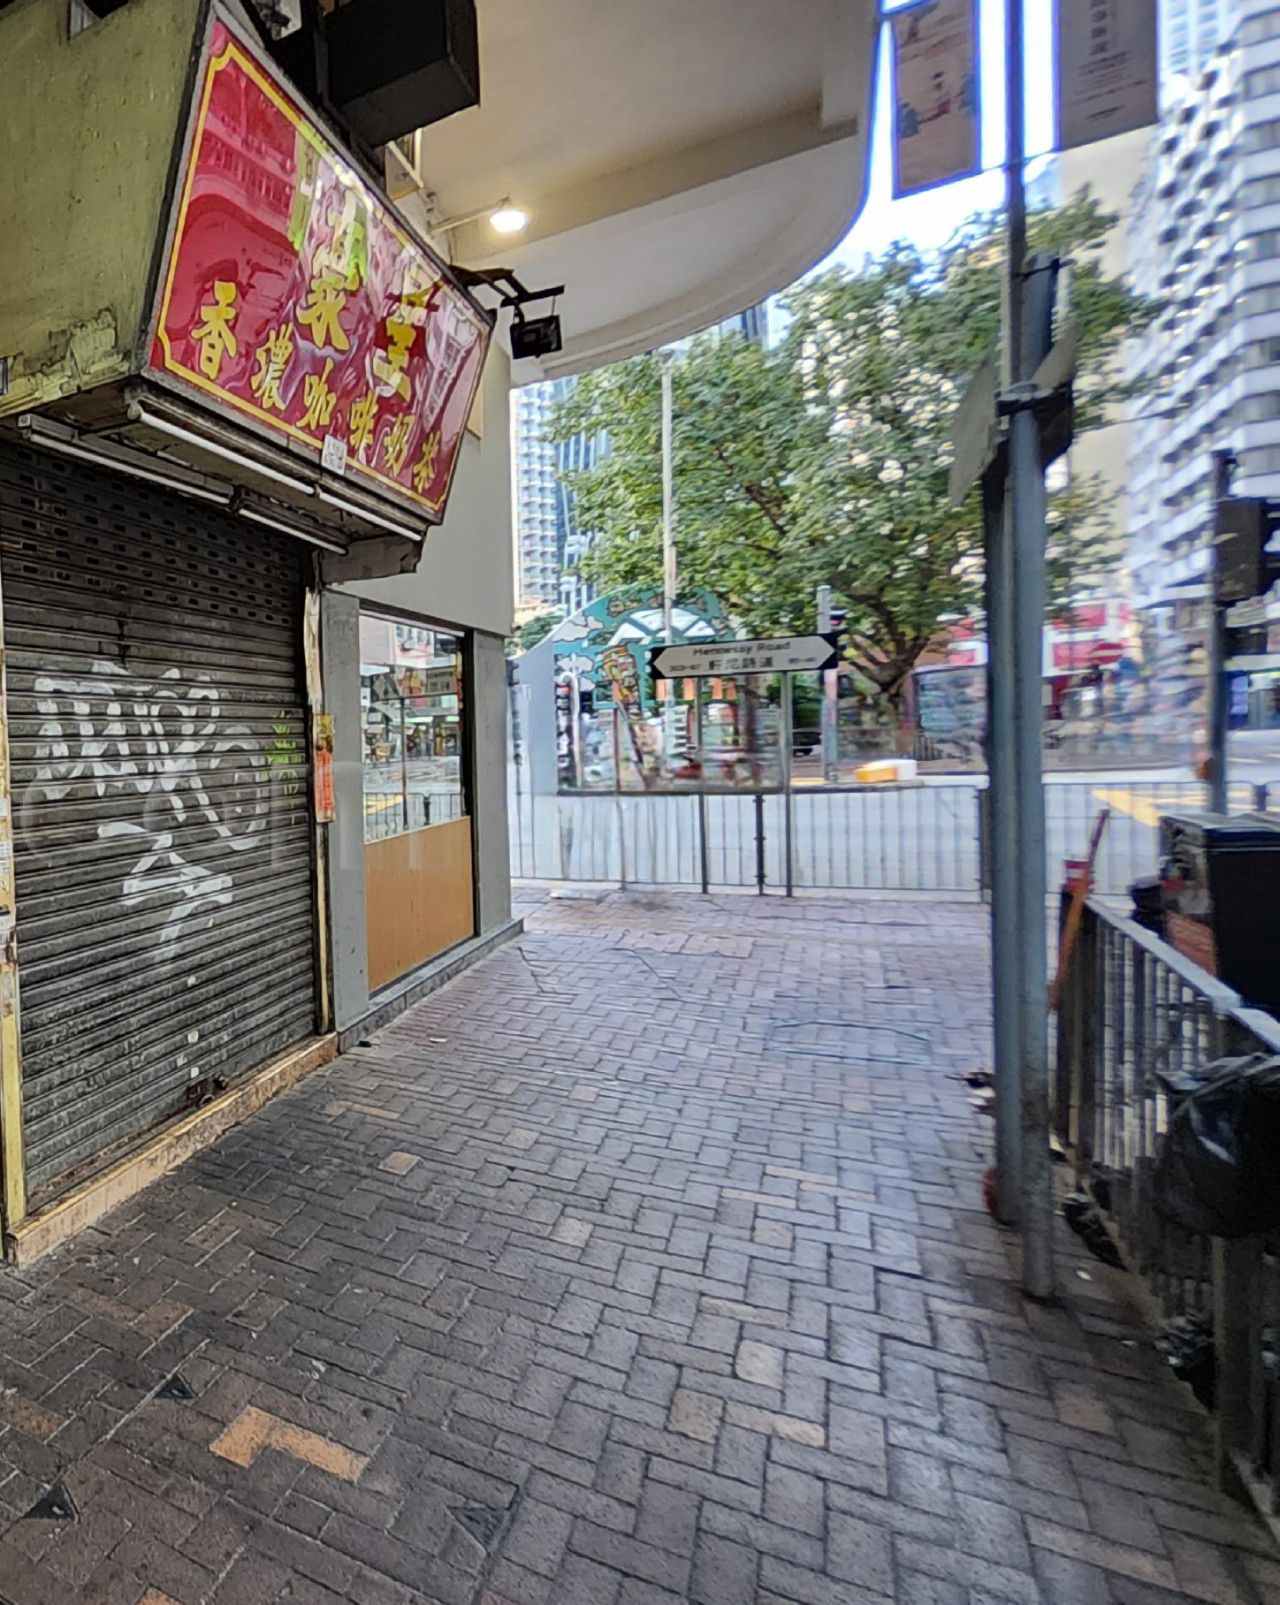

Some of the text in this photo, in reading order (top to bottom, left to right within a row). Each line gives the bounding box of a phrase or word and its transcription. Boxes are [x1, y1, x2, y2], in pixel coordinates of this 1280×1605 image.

[191, 280, 442, 493] 香濃咖啡奶茶
[693, 641, 791, 656] Hennessy Road
